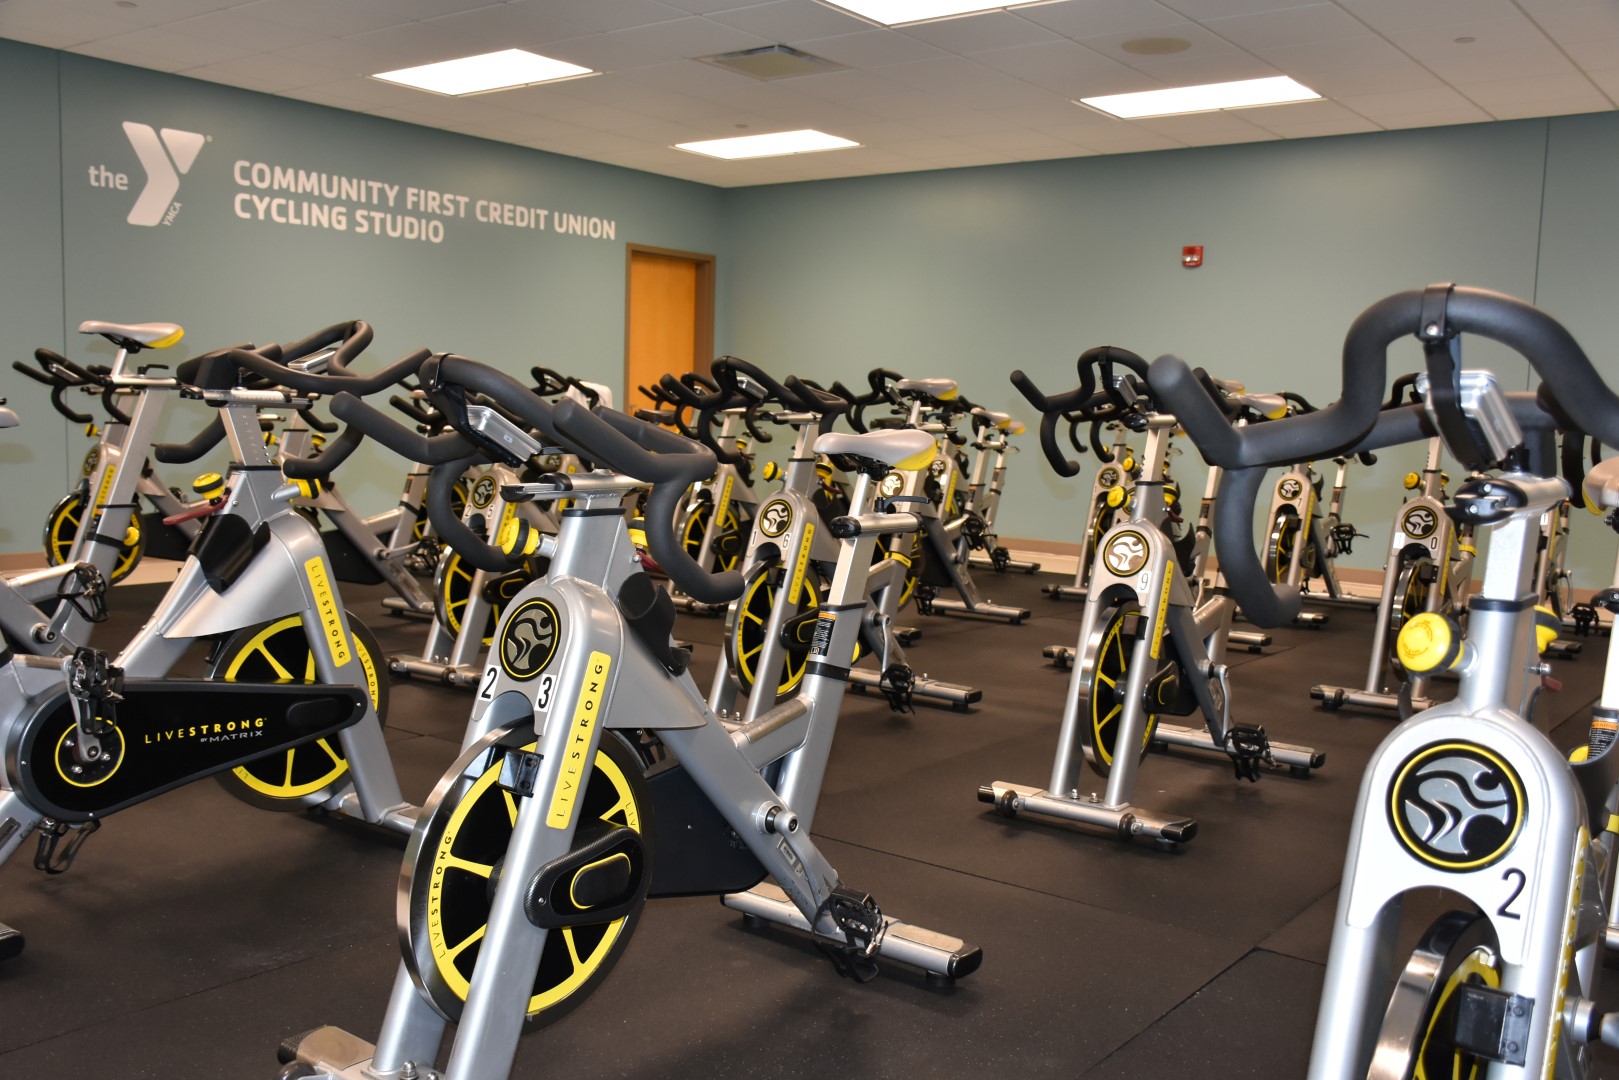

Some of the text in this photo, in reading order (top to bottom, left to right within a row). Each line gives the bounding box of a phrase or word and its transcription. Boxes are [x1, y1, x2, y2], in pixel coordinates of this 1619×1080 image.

[88, 164, 129, 191] the
[162, 201, 183, 227] YMCA
[233, 159, 616, 240] COMMUNITY FIRST CREDIT UNION
[233, 192, 445, 244] CYCLING STUDIO
[782, 533, 790, 549] 6
[1140, 573, 1149, 590] 9
[311, 564, 346, 659] LIVESTRONG
[481, 667, 553, 709] 2 3
[144, 717, 265, 744] LIVESTRONG
[209, 730, 263, 743] MATRIX
[556, 664, 603, 818] LIVESTRONG
[431, 835, 453, 959] LIVESTRONG
[1496, 867, 1527, 921] 2
